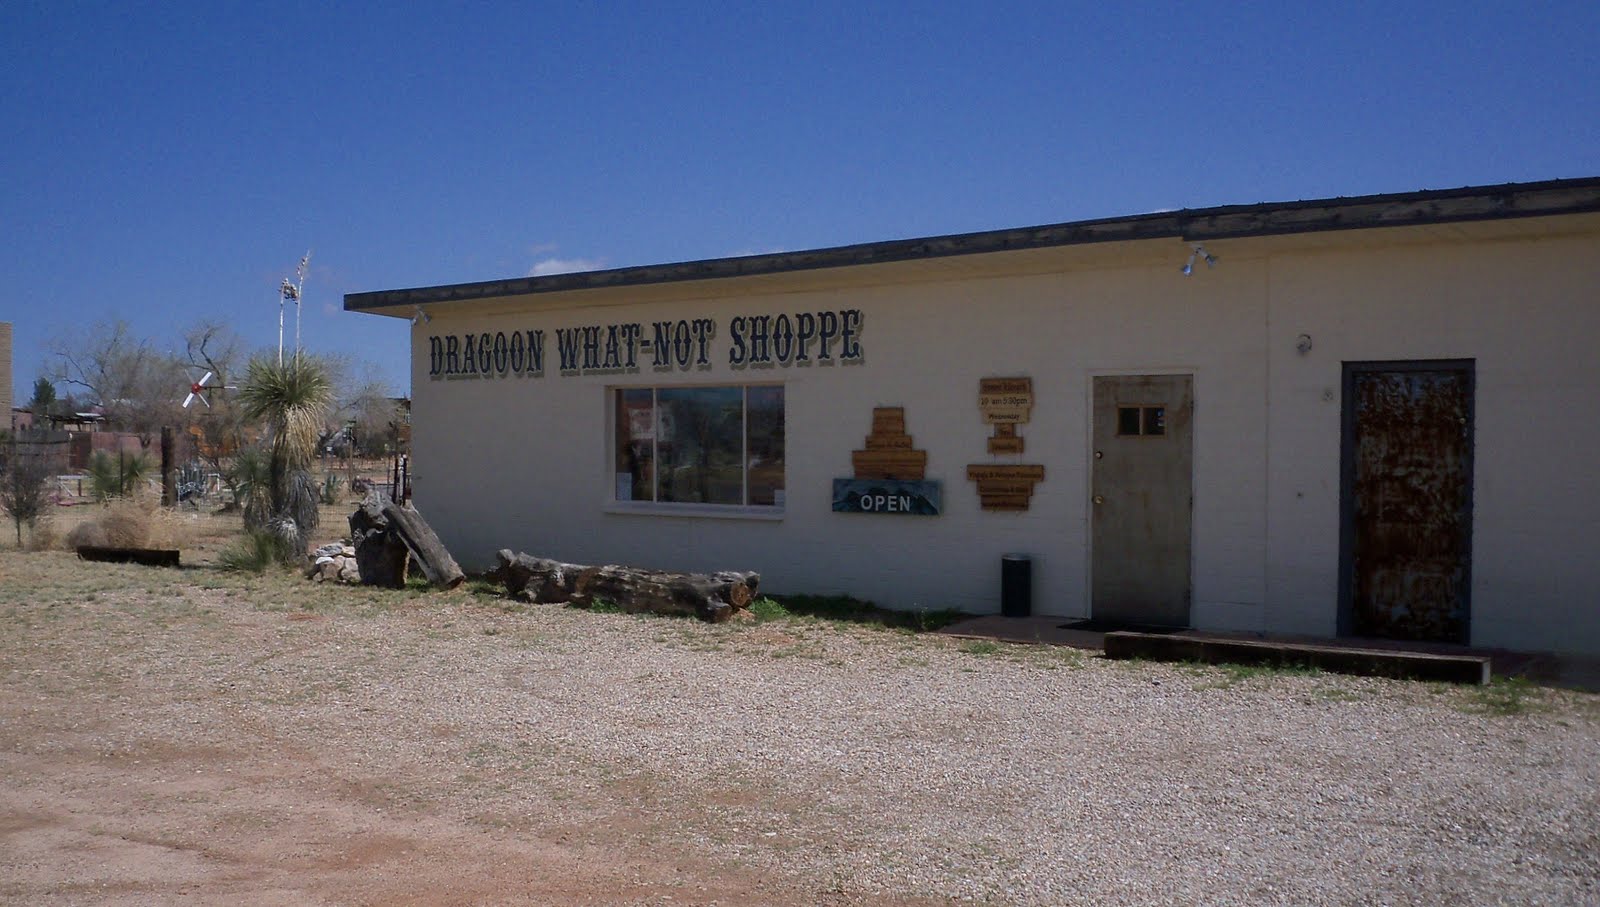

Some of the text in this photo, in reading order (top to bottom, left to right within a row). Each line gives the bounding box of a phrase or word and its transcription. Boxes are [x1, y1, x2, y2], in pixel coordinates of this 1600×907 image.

[429, 308, 863, 379] DRAGOON WHAT-NOT SHOPPE
[860, 495, 911, 512] OPEN
